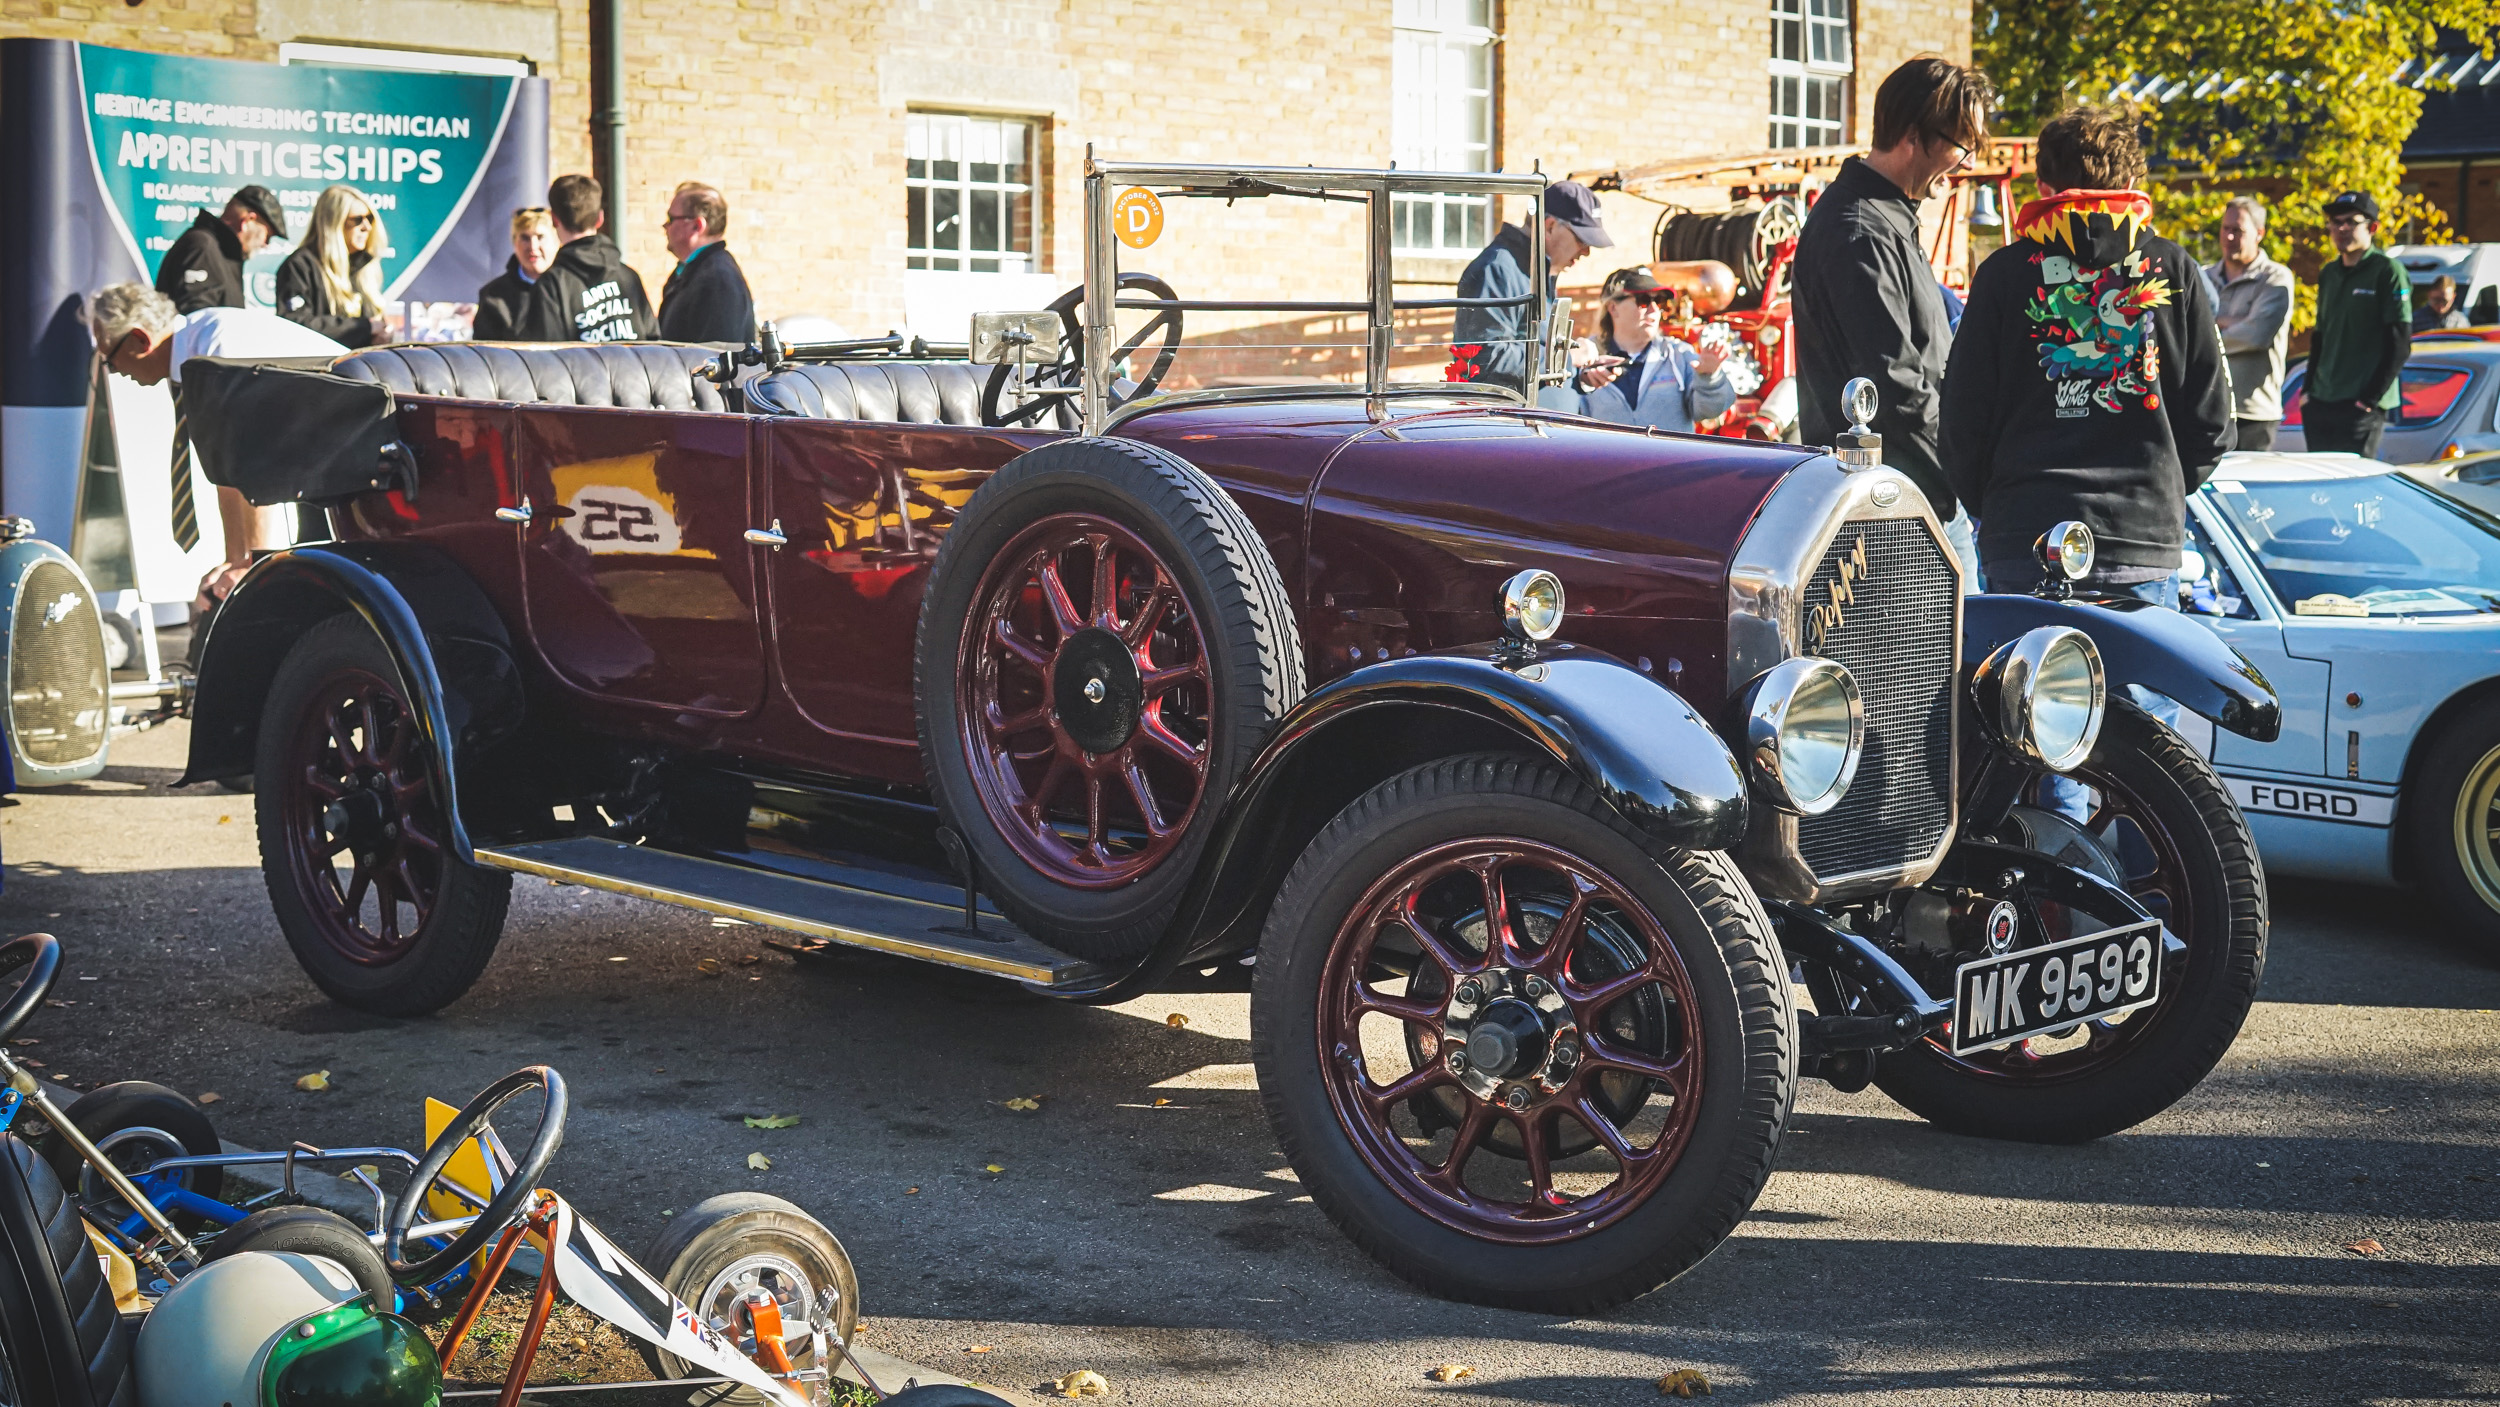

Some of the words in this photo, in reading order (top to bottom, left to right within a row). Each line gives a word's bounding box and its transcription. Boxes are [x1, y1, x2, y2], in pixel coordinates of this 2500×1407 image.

[95, 93, 172, 122] HERITAGE
[174, 101, 318, 132] ENGINEERING
[322, 110, 470, 138] TECHNICIAN
[117, 130, 443, 184] APPRENTICESHIPS
[155, 183, 211, 202] CLASSIC
[1117, 192, 1147, 211] OCTOBER
[1148, 198, 1160, 216] 2022
[1128, 205, 1151, 233] D
[582, 281, 621, 308] ANTI
[574, 298, 634, 329] SOCIAL
[580, 319, 638, 343] SOCIAL
[2055, 390, 2089, 408] WINGS
[2057, 379, 2091, 397] HOT
[2251, 785, 2357, 817] FORD
[1968, 963, 2031, 1039] MK
[2039, 935, 2152, 1019] 9593
